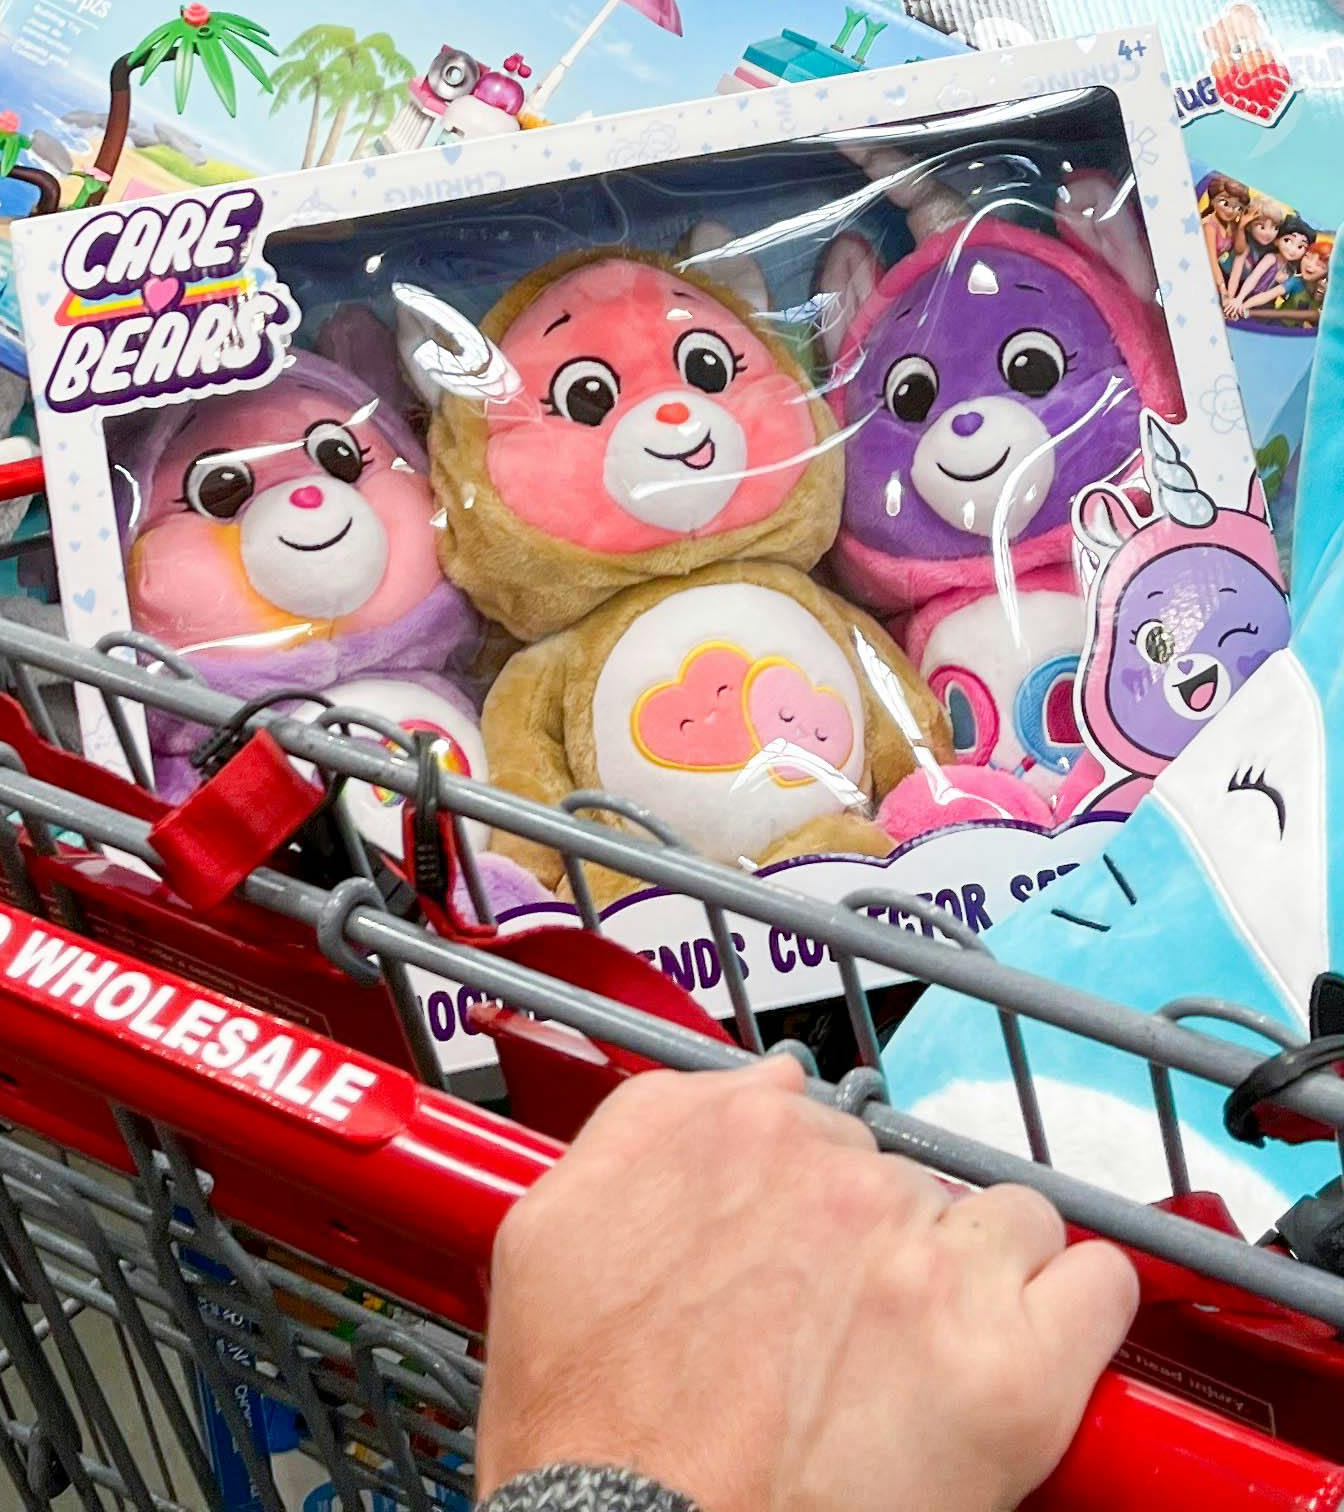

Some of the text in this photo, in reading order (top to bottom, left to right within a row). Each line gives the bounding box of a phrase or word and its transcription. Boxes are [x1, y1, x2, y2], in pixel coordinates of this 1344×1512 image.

[1118, 39, 1147, 61] 4+
[64, 191, 258, 292] CARE
[48, 292, 280, 403] BEARS
[6, 930, 377, 1121] WHOLESALE
